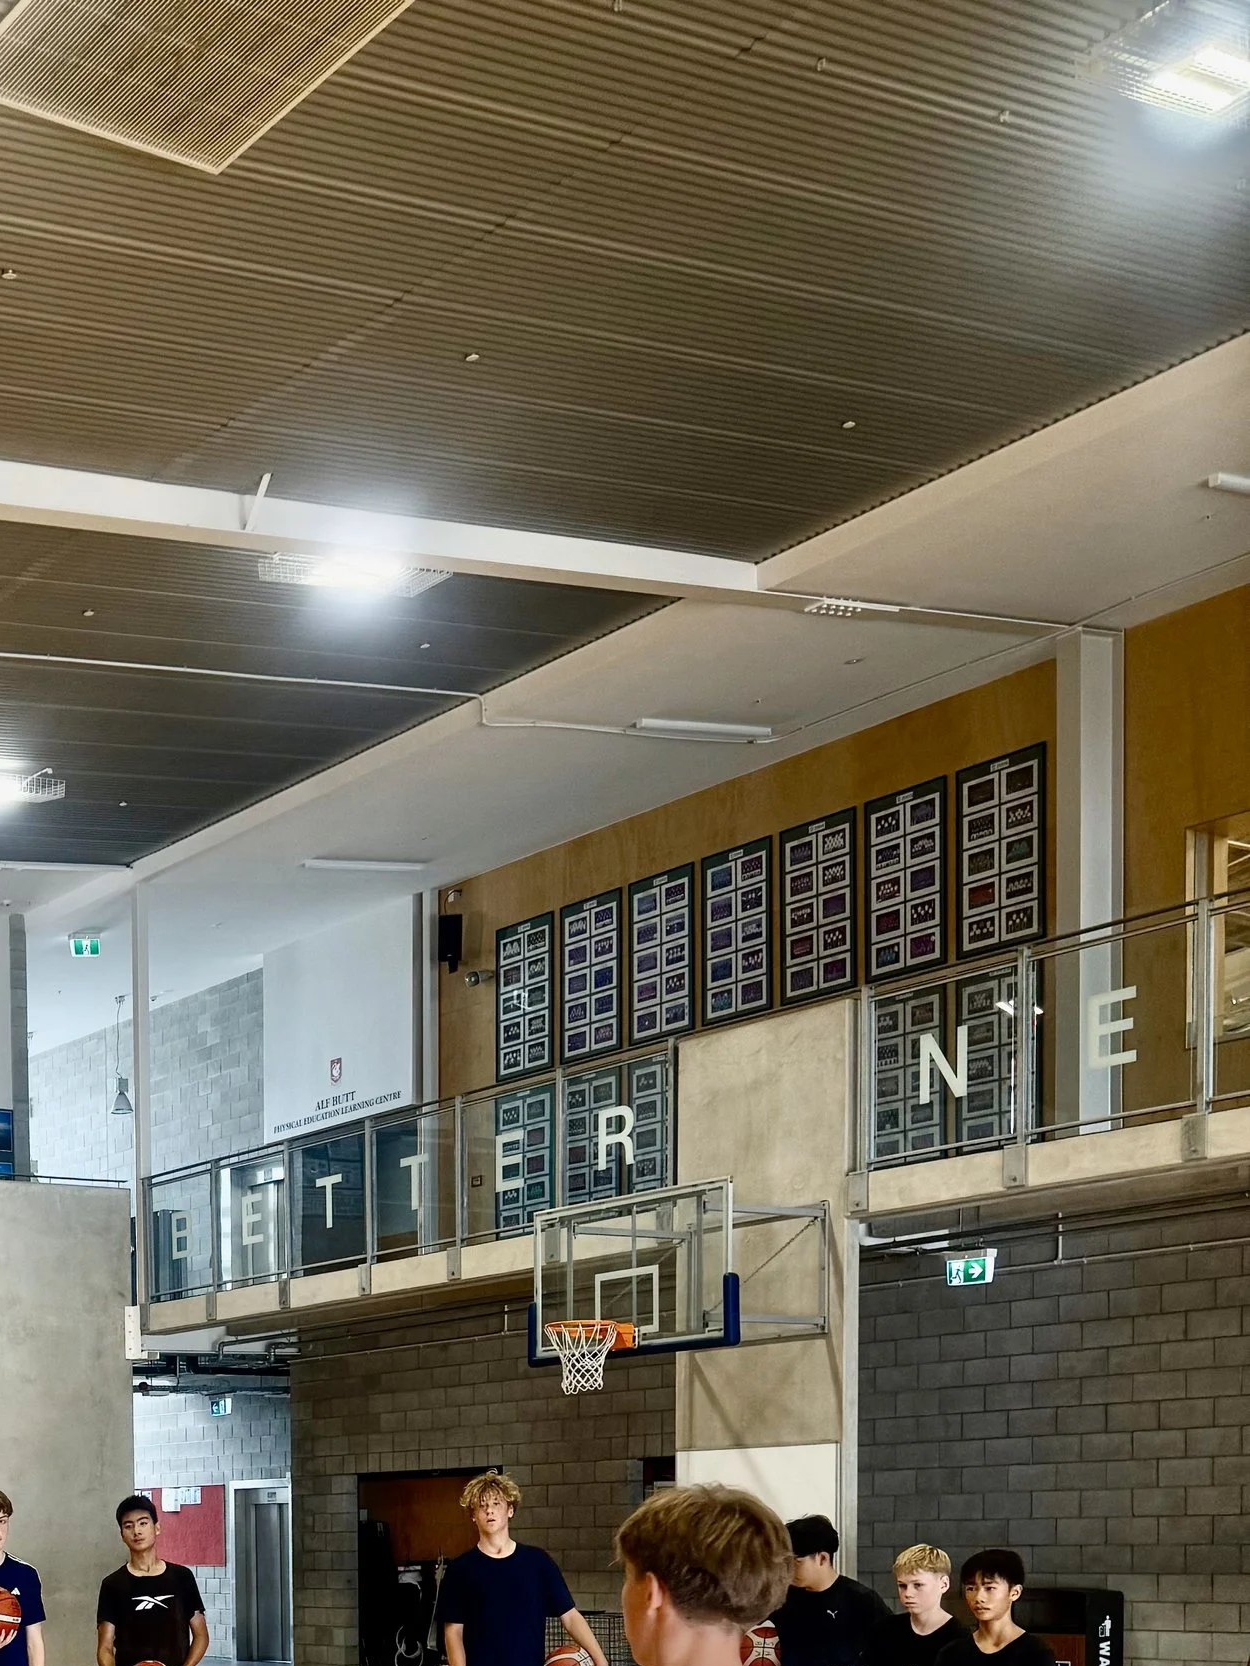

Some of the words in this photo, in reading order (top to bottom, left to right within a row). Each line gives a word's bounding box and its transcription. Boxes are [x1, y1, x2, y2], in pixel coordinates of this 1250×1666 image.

[273, 1120, 302, 1134] PHYSICAL
[304, 1109, 340, 1125] EDUCATION
[341, 1100, 375, 1115] LEARNING
[375, 1091, 402, 1105] CENTRE
[315, 1098, 330, 1111] ALF
[332, 1091, 356, 1106] BUTT
